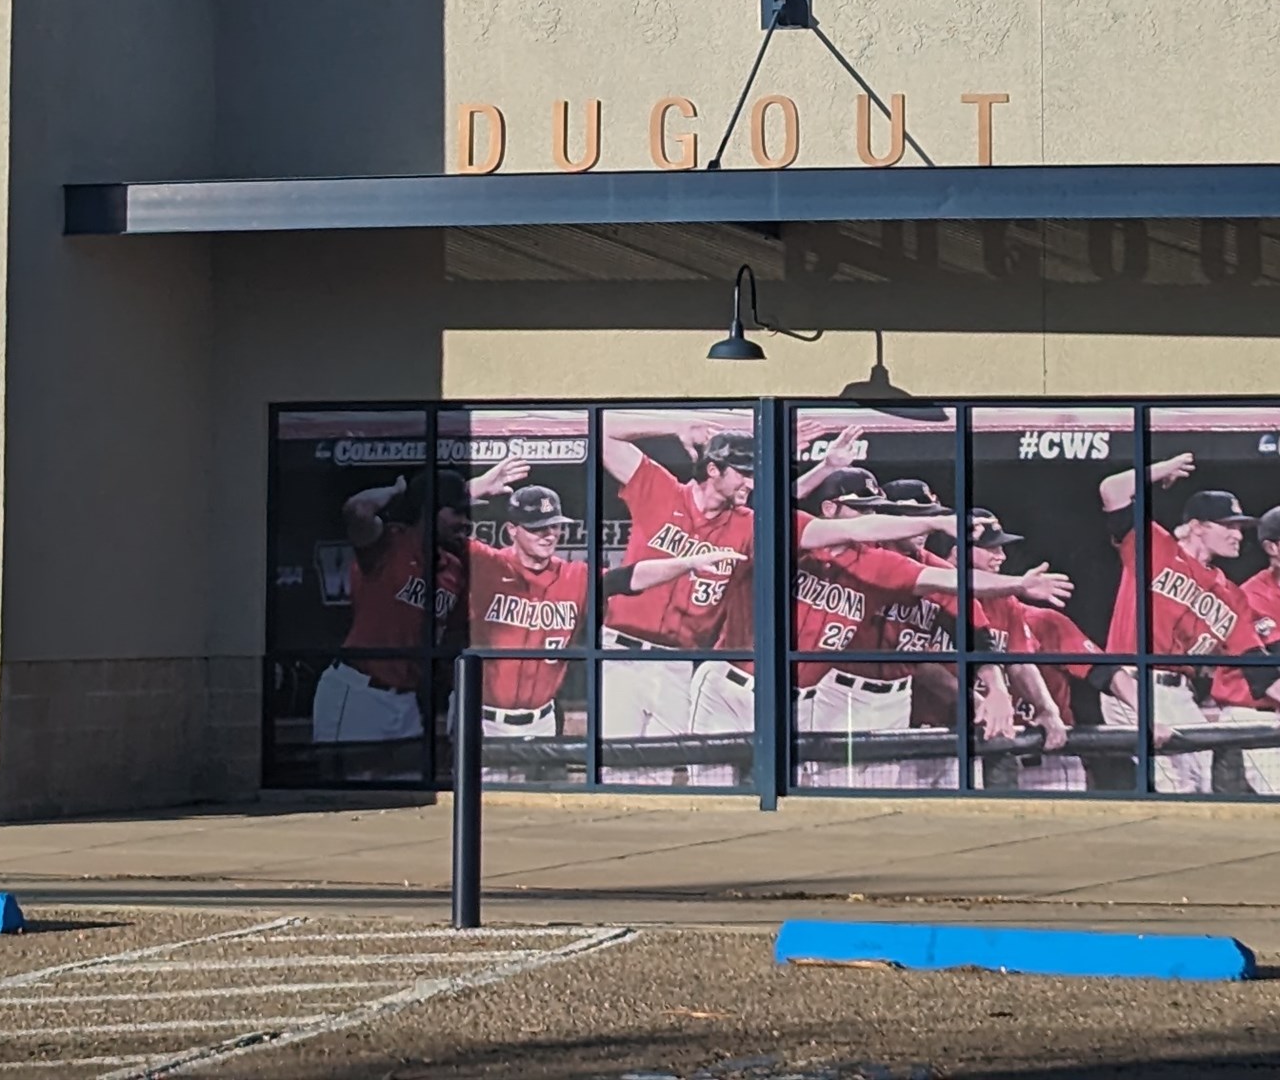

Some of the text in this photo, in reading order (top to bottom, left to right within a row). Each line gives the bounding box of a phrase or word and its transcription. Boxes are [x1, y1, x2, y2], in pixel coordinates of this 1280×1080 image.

[457, 92, 1010, 174] DUGOUT
[508, 437, 587, 462] SERIES
[1018, 430, 1111, 461] #CWS
[797, 570, 866, 622] RIZONA
[1152, 568, 1239, 641] ARIZONA
